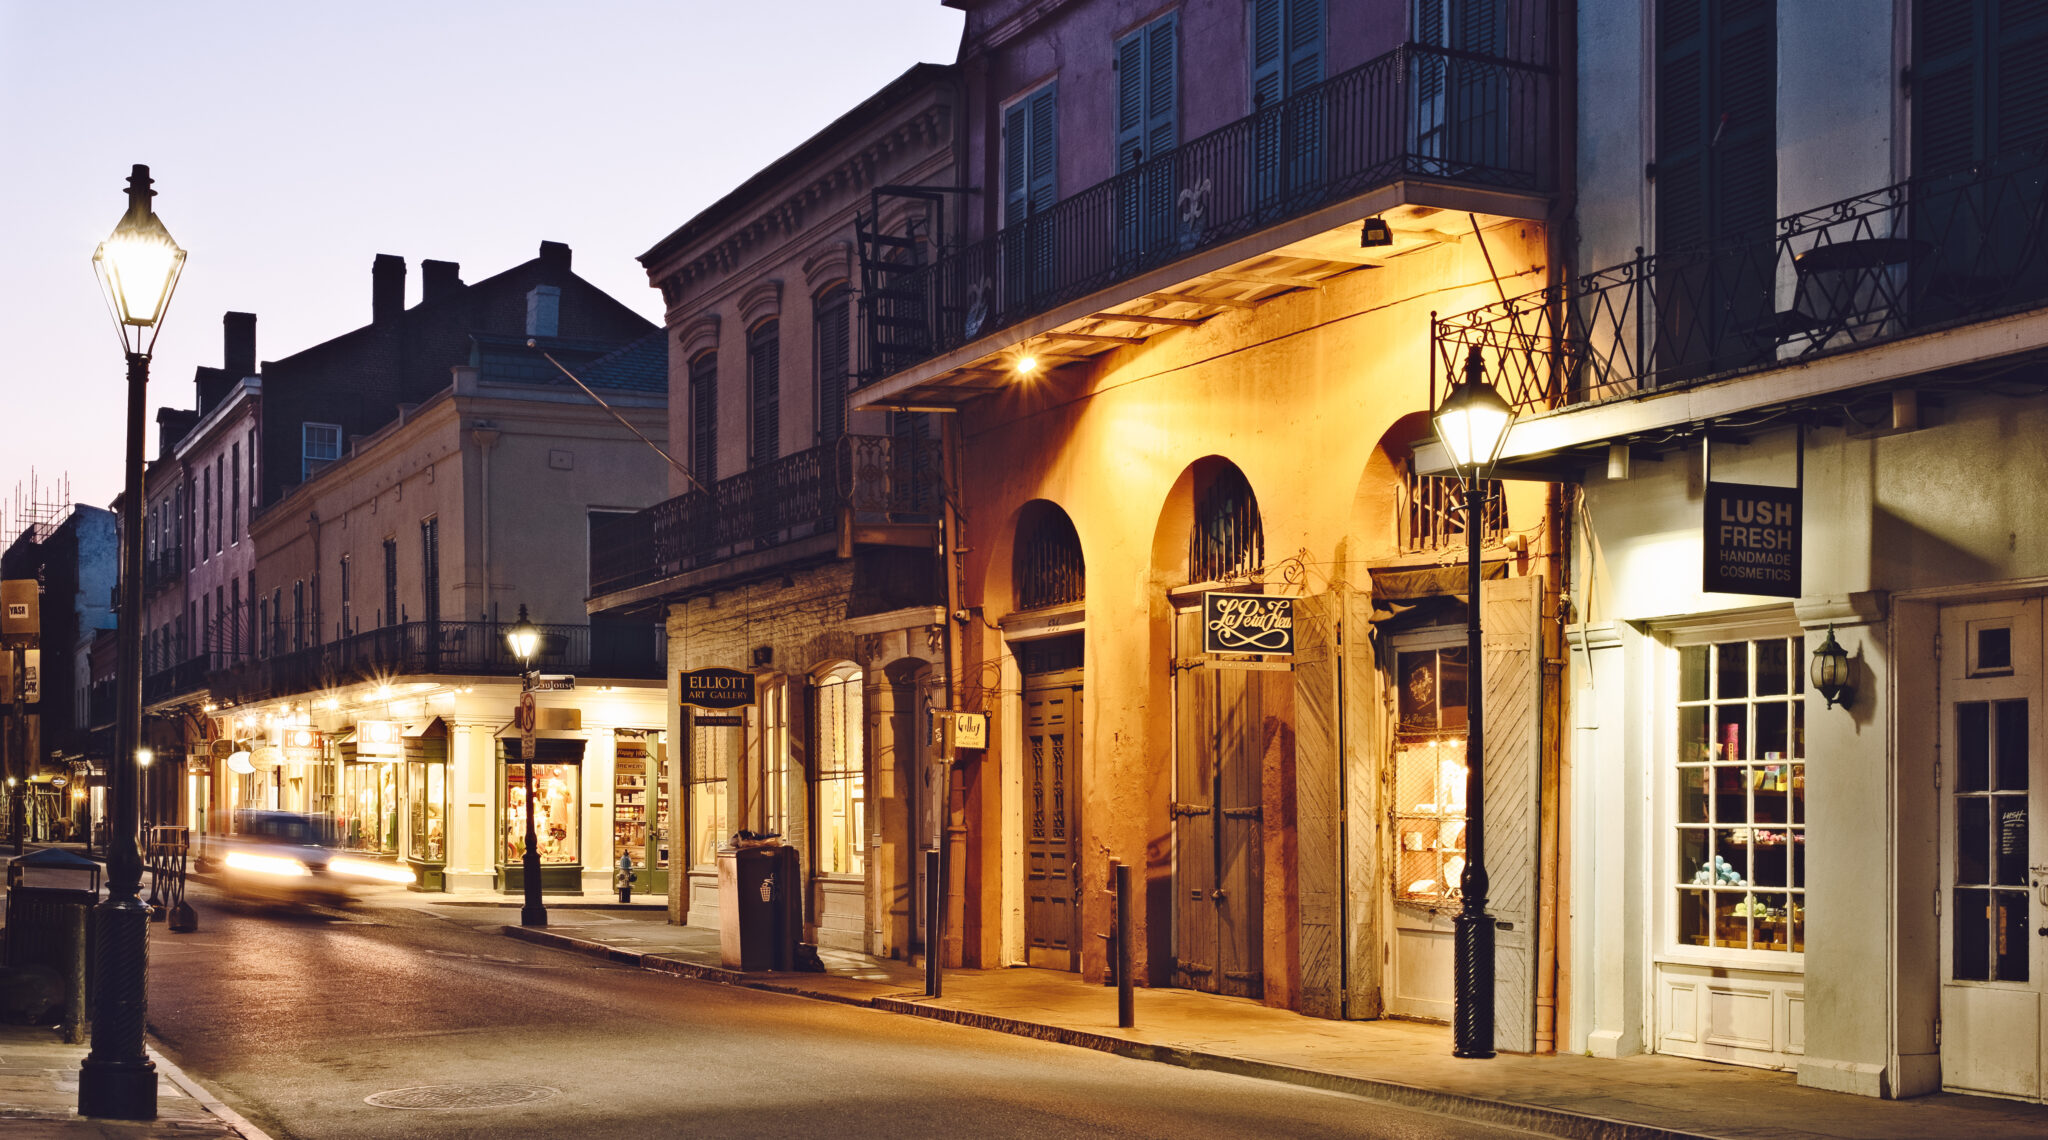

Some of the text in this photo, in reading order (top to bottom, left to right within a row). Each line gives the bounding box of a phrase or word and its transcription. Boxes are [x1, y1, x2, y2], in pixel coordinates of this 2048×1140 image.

[1720, 498, 1793, 526] LUSH
[1720, 525, 1793, 550] FRESH
[1720, 550, 1791, 566] HANDMADE
[1720, 565, 1791, 582] COSMETICS
[1209, 598, 1239, 631] La
[540, 681, 575, 690] oulouse
[690, 676, 748, 689] ELLIOTT
[689, 691, 748, 700] ART GALLERY
